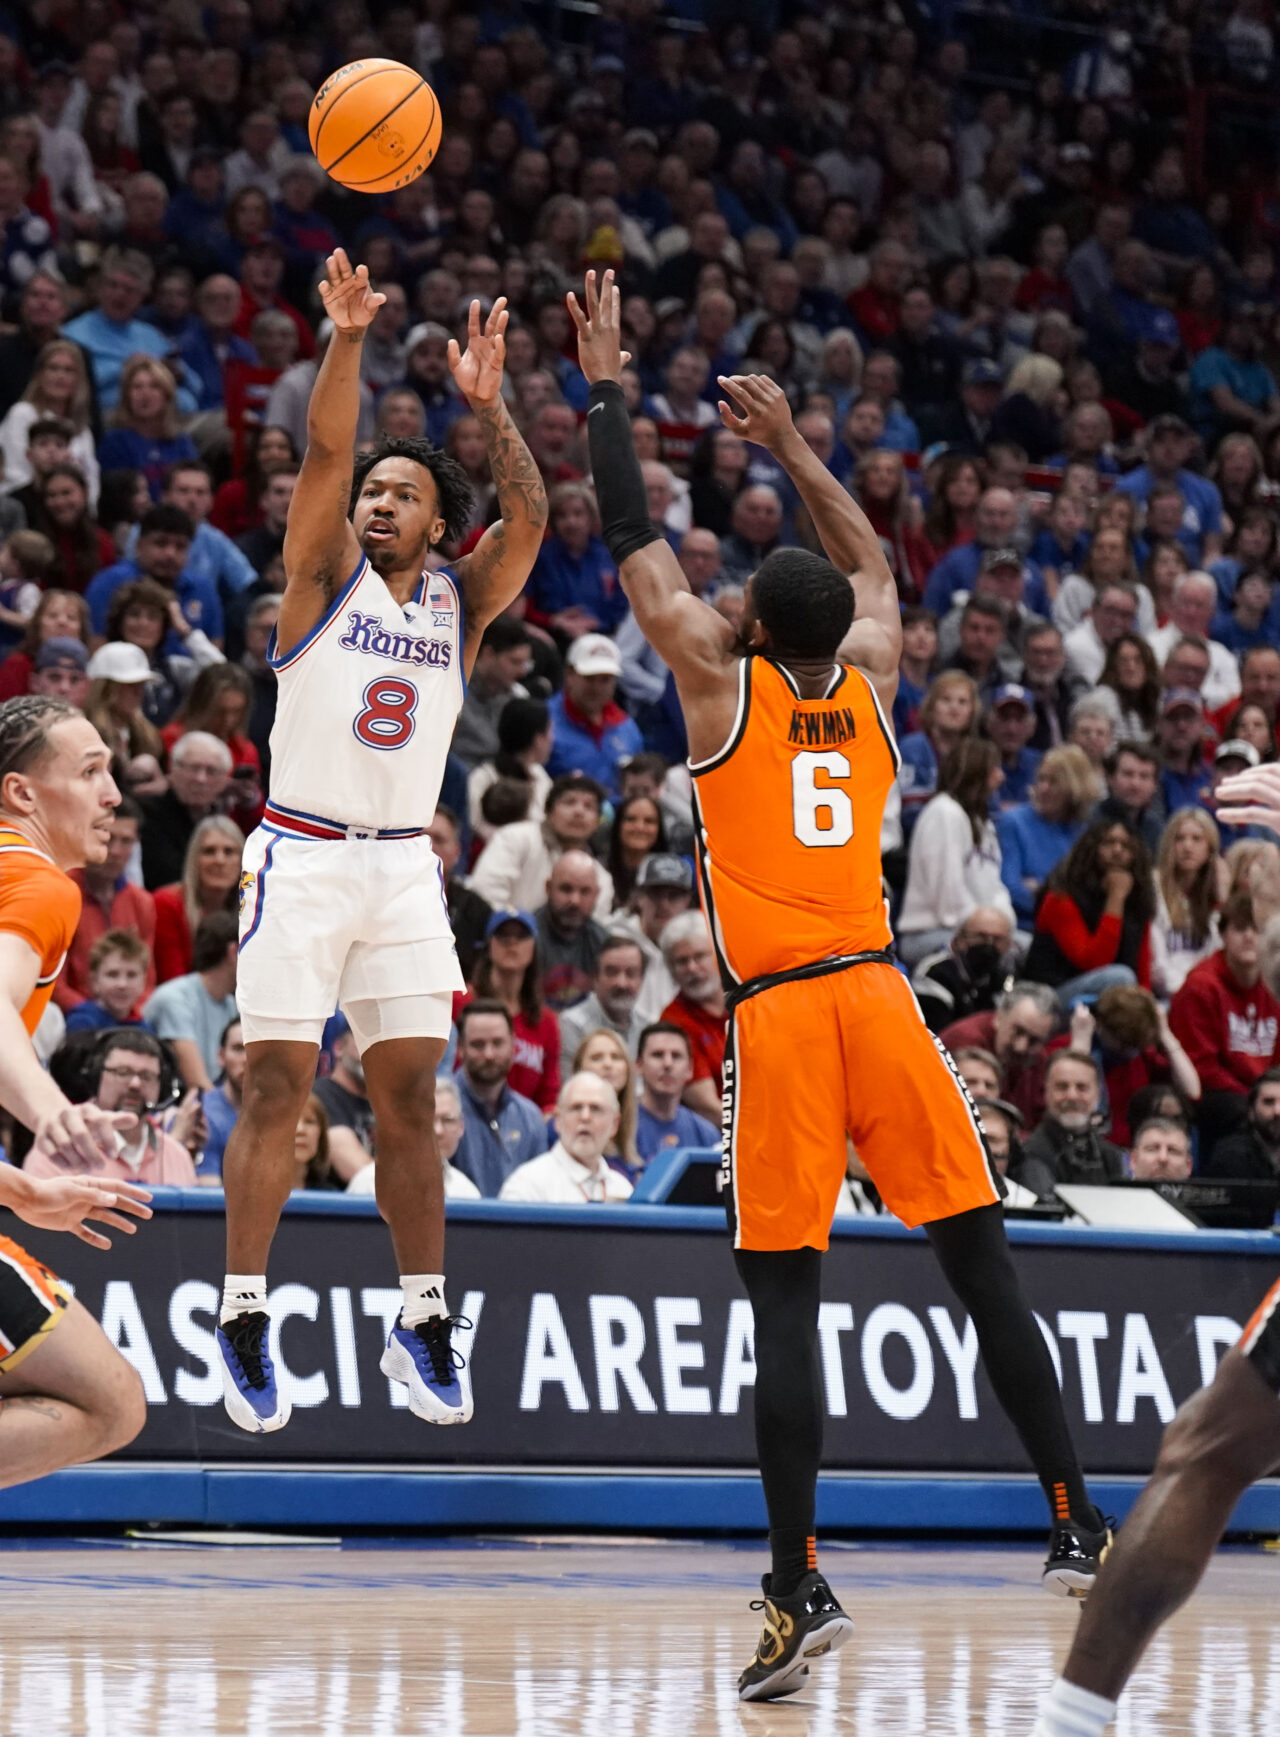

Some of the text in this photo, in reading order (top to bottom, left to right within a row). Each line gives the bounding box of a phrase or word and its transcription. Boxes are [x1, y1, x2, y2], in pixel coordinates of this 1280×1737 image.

[338, 611, 454, 671] Kansas
[353, 675, 420, 752] 8
[787, 706, 857, 746] NEWMAN
[791, 750, 855, 849] 6
[519, 1292, 758, 1415] AREA
[817, 1301, 1177, 1424] TOYTA
